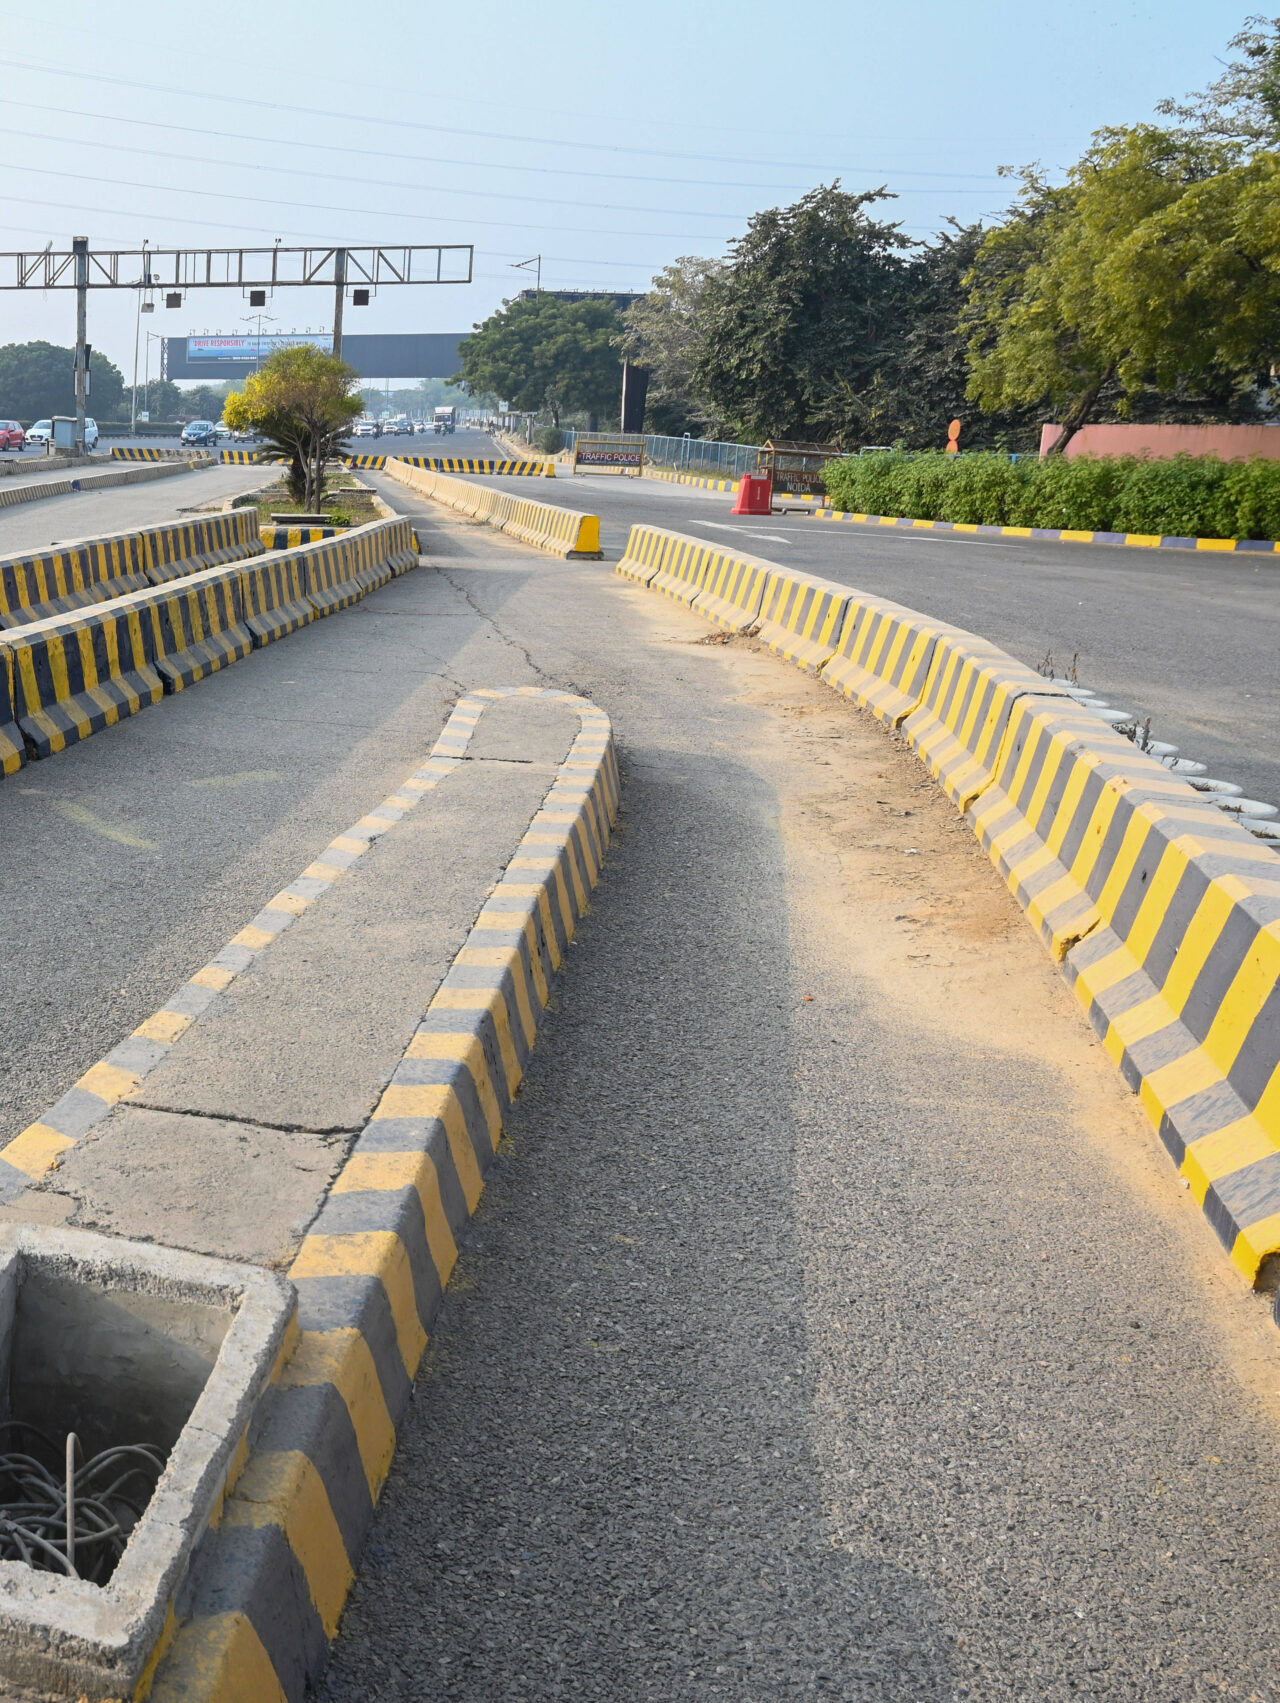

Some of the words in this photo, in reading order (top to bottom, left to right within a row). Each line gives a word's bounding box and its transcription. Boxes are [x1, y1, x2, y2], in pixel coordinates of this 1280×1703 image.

[581, 452, 612, 461] TRAFFIC
[613, 453, 641, 462] POLICE
[776, 471, 801, 482] TRAFFIC
[786, 482, 811, 493] NOIDA
